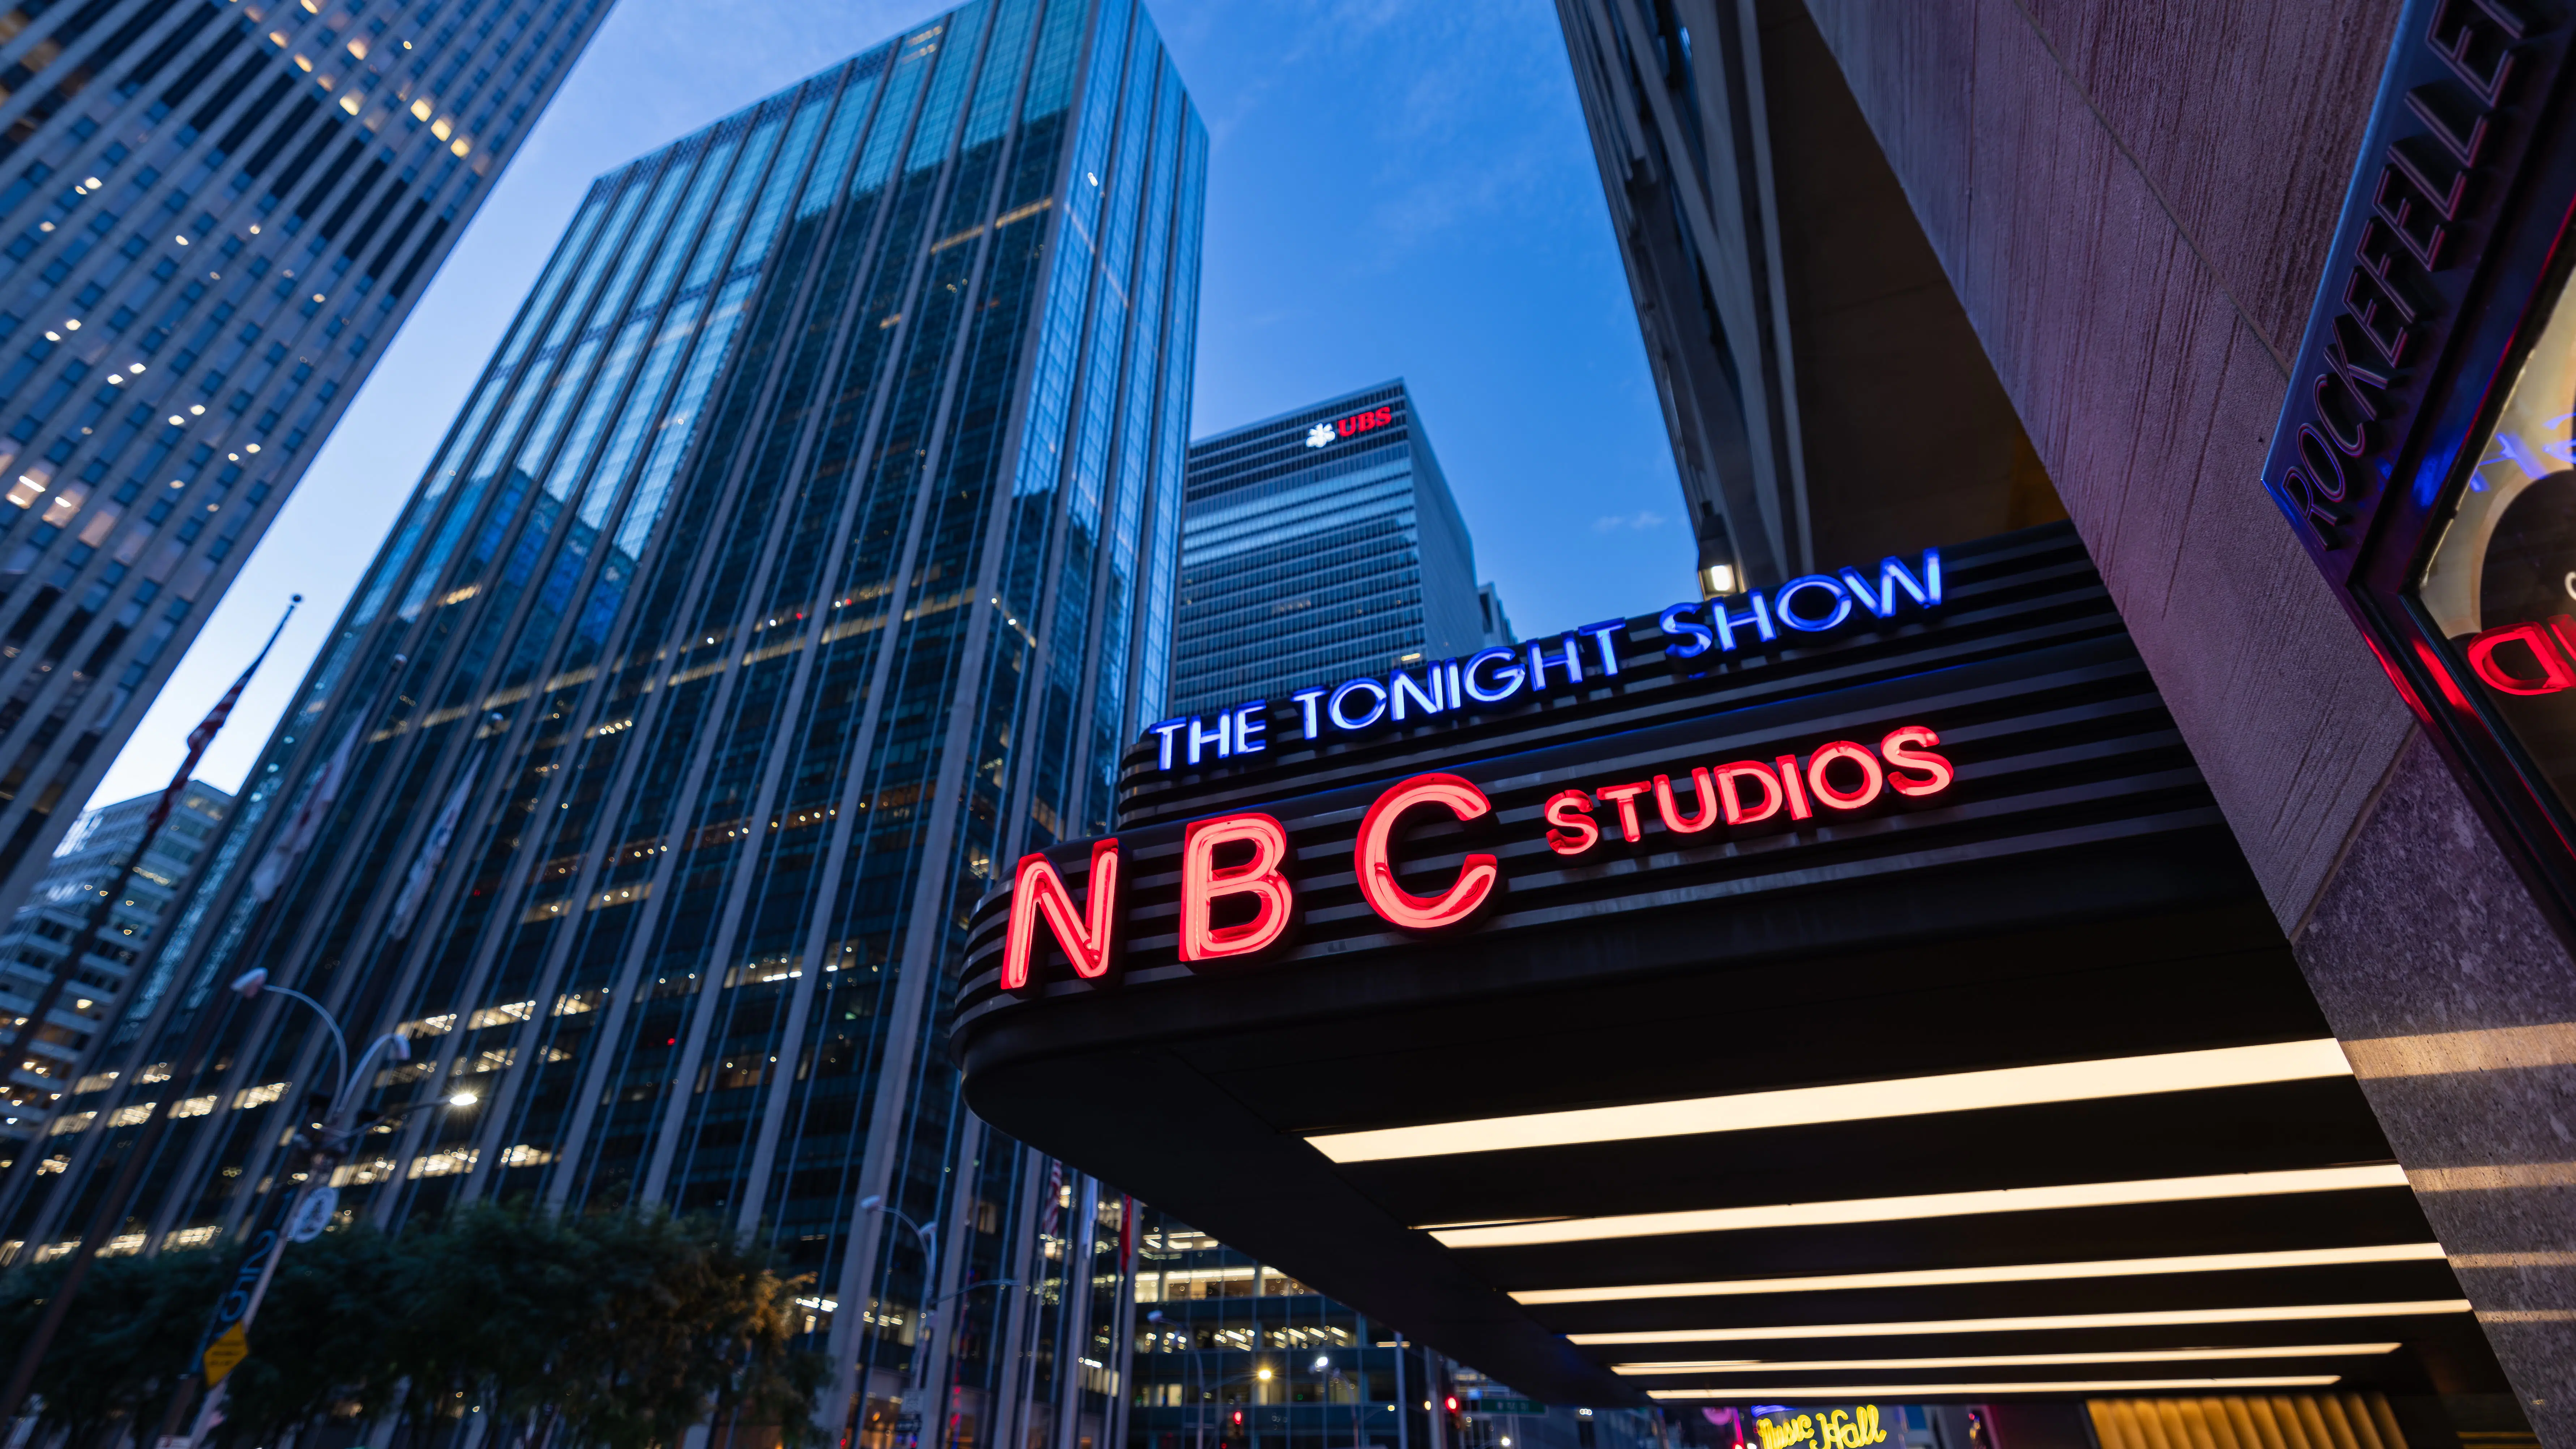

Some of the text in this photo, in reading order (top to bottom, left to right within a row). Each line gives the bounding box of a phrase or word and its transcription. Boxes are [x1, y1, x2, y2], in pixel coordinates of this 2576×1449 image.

[2282, 0, 2525, 552] ROCKEFELLE
[1337, 406, 1392, 437] UBS
[1149, 547, 1943, 771] THE TONIGHT SHOW
[1544, 725, 1954, 856] STUDIOS
[1809, 1404, 1887, 1449] Hall
